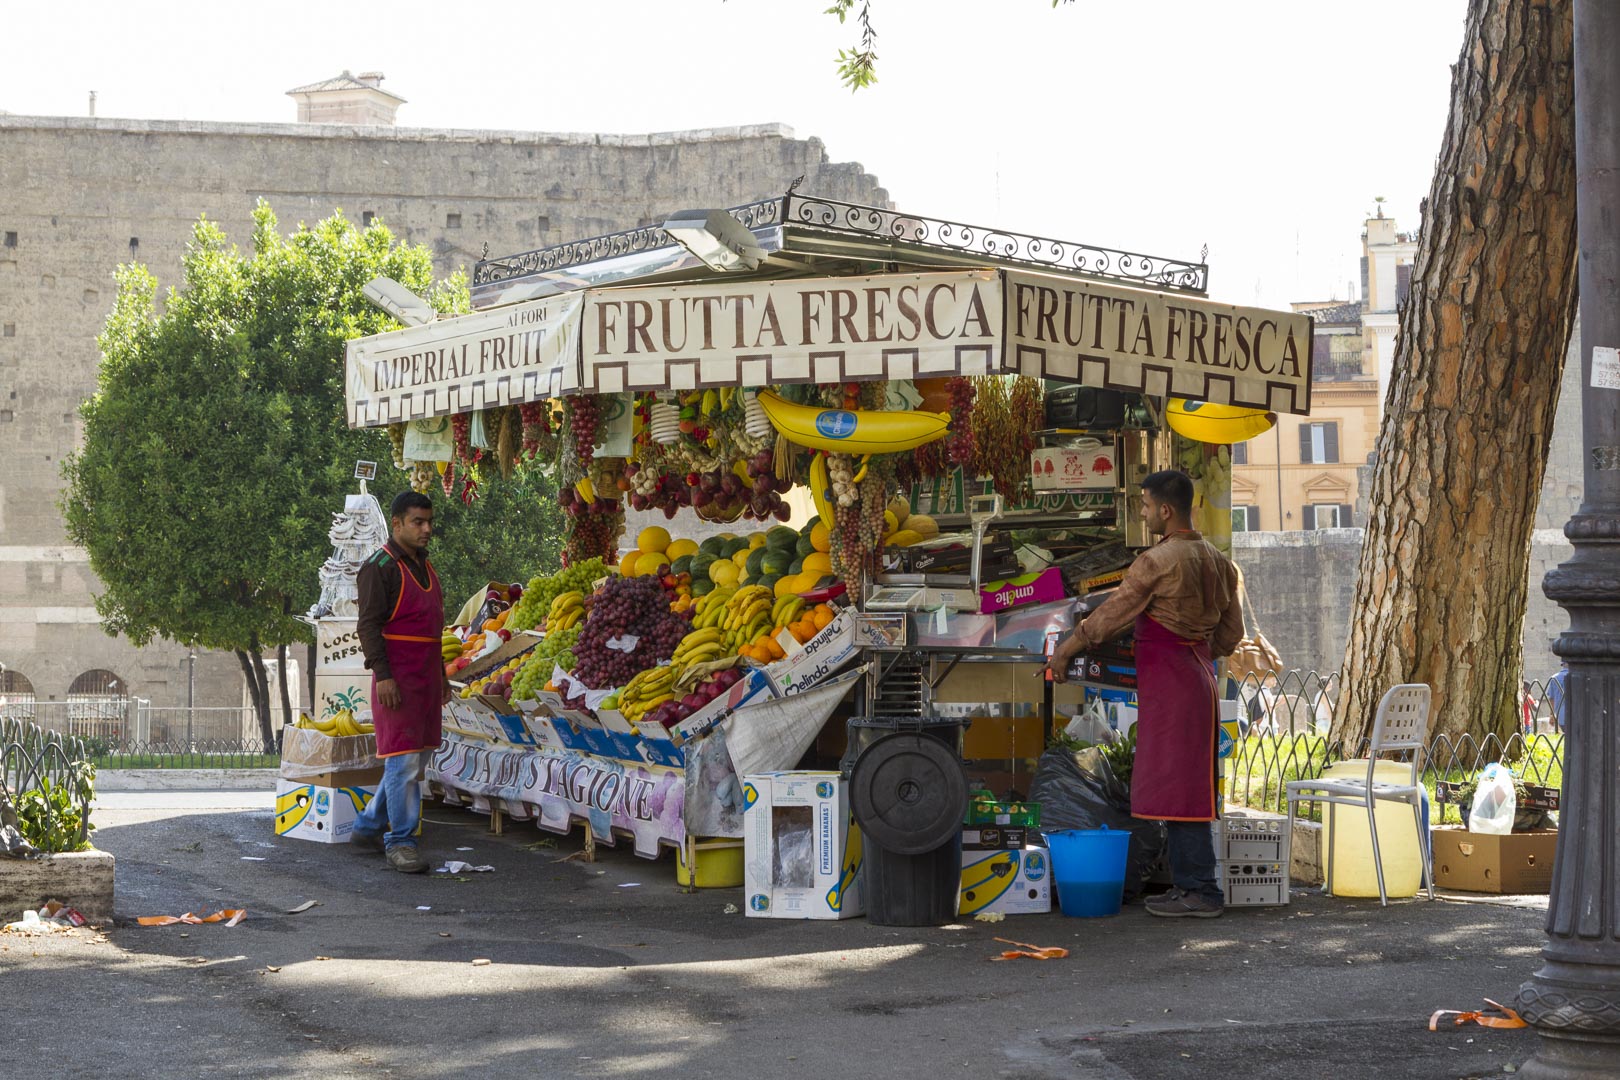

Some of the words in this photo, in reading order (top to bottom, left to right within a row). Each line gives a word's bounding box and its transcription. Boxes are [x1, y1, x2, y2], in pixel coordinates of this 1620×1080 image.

[521, 306, 547, 325] FORI
[593, 292, 787, 355] FRUTTA
[797, 283, 995, 346] FRESCA
[1014, 282, 1156, 358] FRUTTA
[1163, 305, 1302, 378] FRESCA
[374, 343, 474, 393] IMPERIAL
[479, 328, 547, 374] FRUIT
[785, 665, 829, 697] Melinda
[428, 739, 493, 784] RUTTA
[524, 756, 655, 822] STAGIONE
